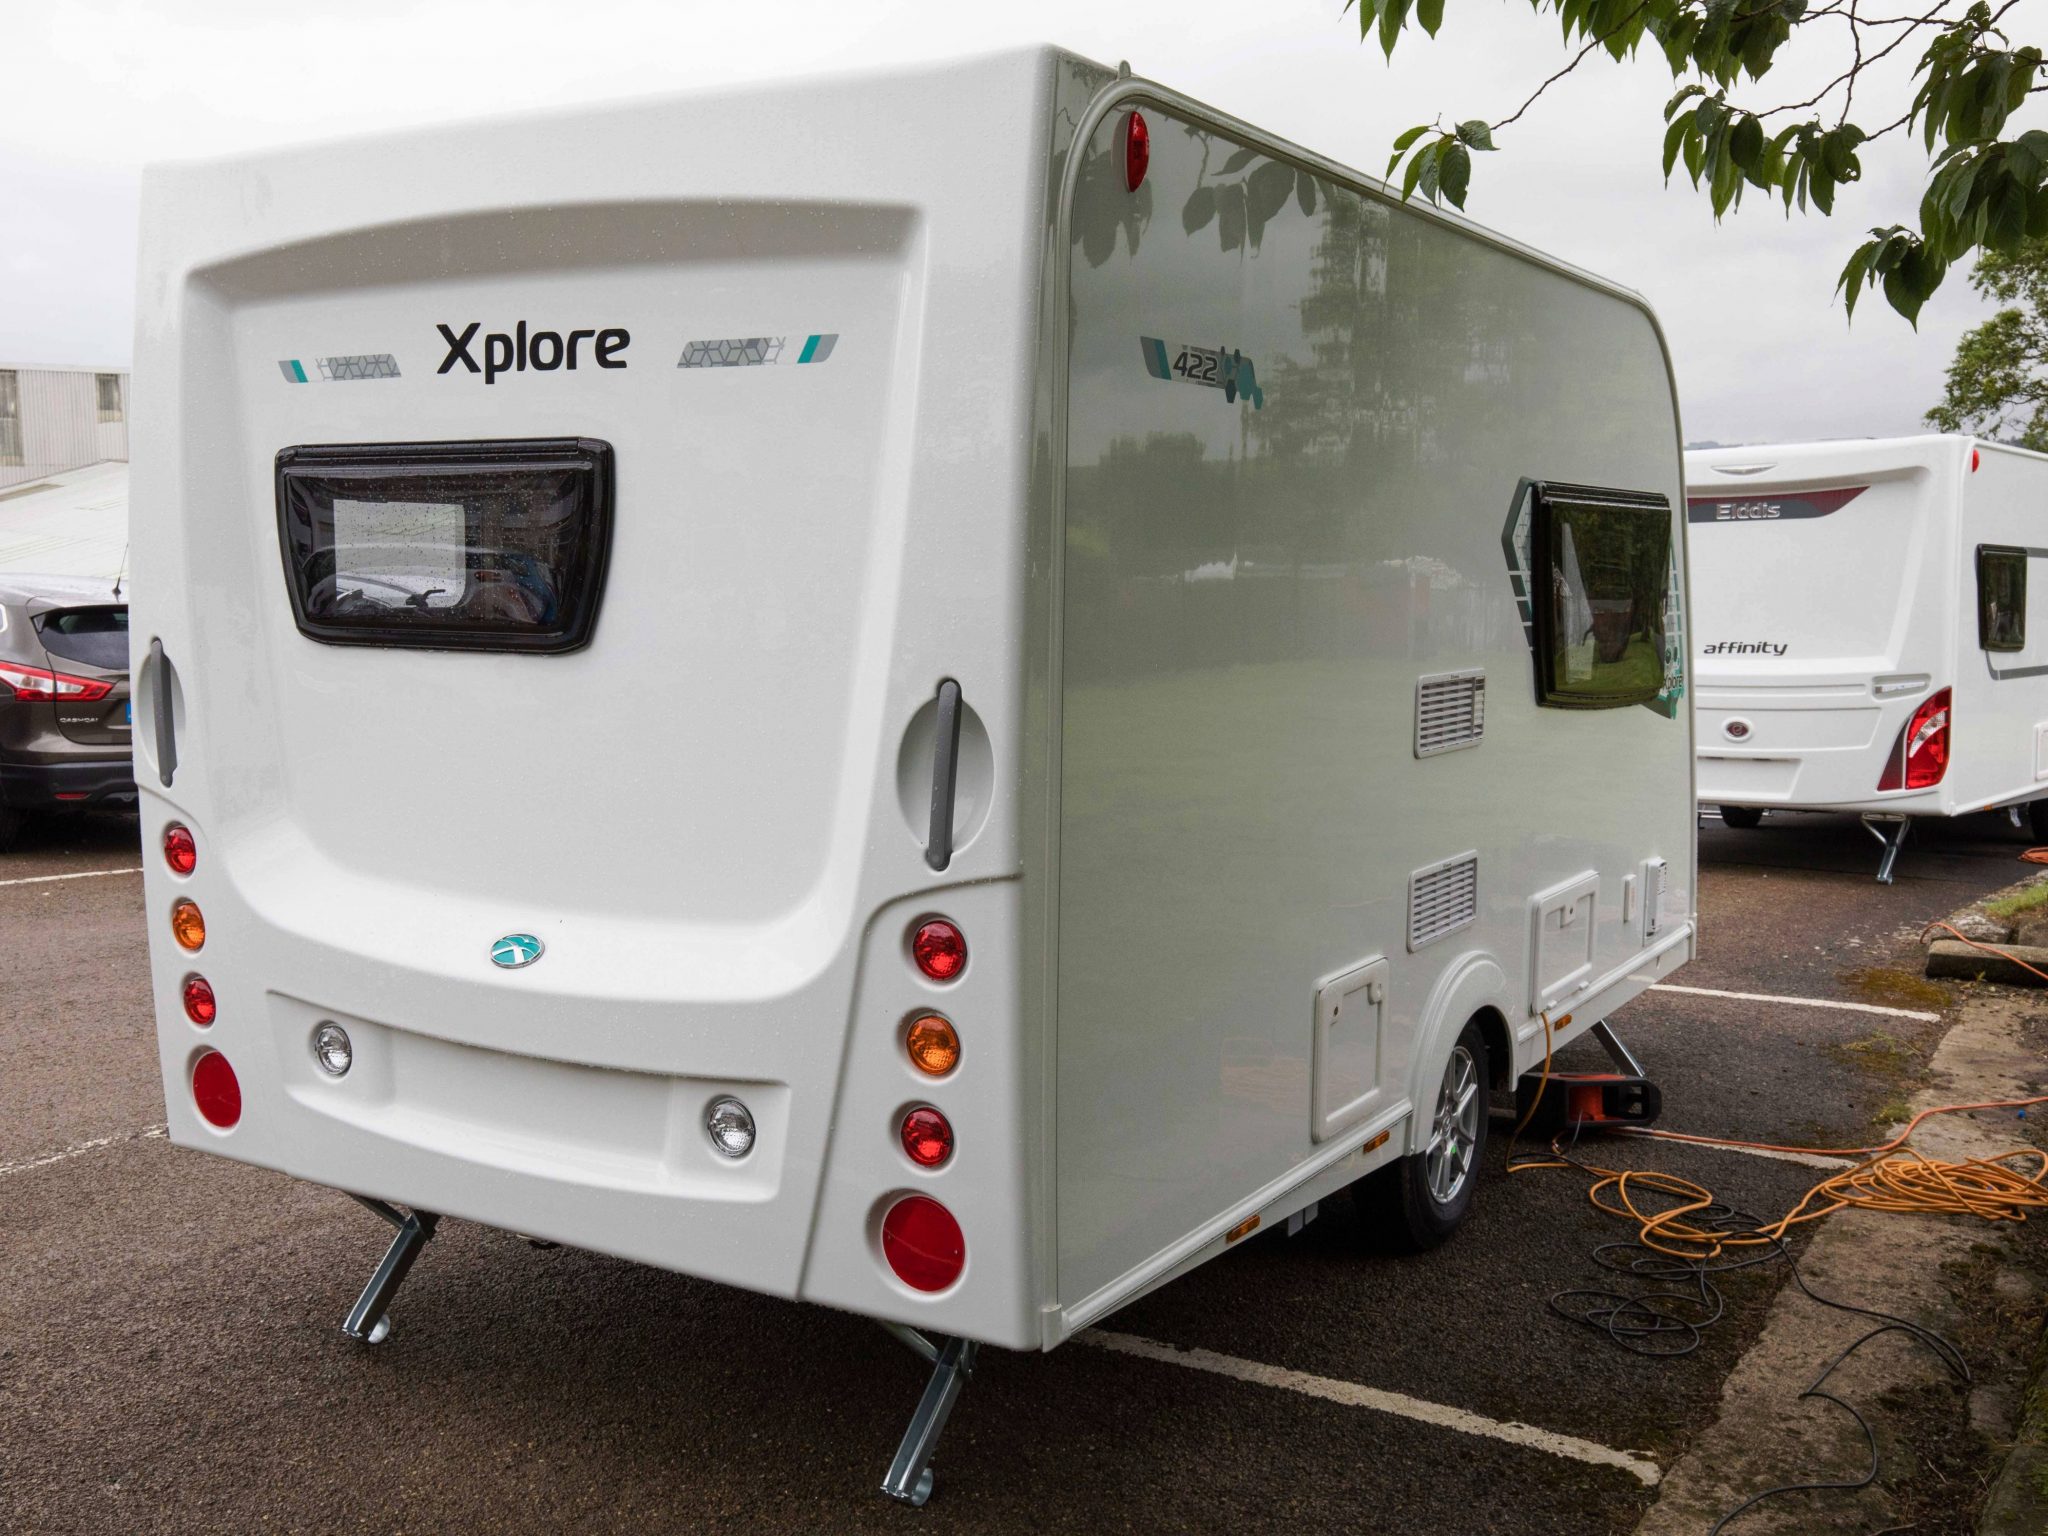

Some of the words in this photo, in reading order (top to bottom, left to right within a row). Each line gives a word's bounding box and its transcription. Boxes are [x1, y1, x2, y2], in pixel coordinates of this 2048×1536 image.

[436, 320, 631, 384] Xplore
[1173, 352, 1218, 382] 422
[1716, 502, 1781, 520] Elddis
[1703, 641, 1788, 656] affinity
